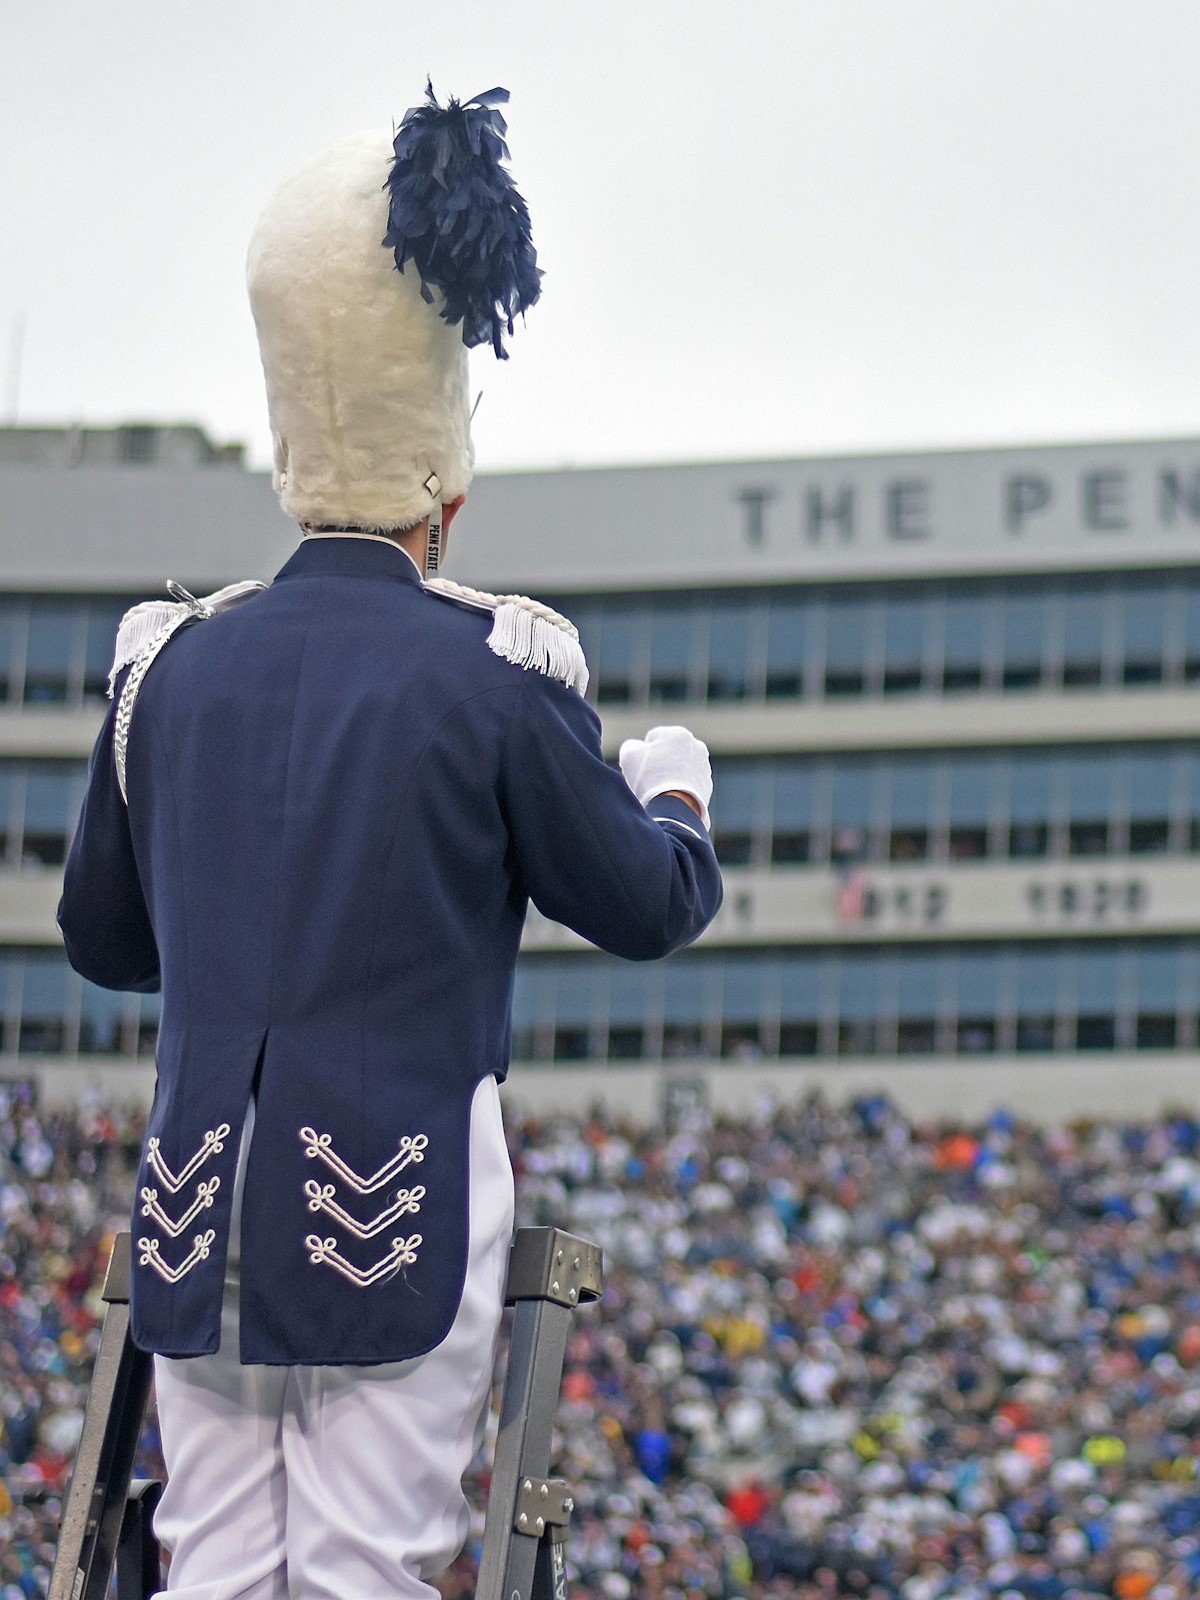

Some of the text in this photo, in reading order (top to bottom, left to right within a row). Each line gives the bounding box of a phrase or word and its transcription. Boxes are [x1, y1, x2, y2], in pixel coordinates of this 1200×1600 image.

[735, 482, 931, 548] THE
[427, 524, 440, 571] PENN STATE
